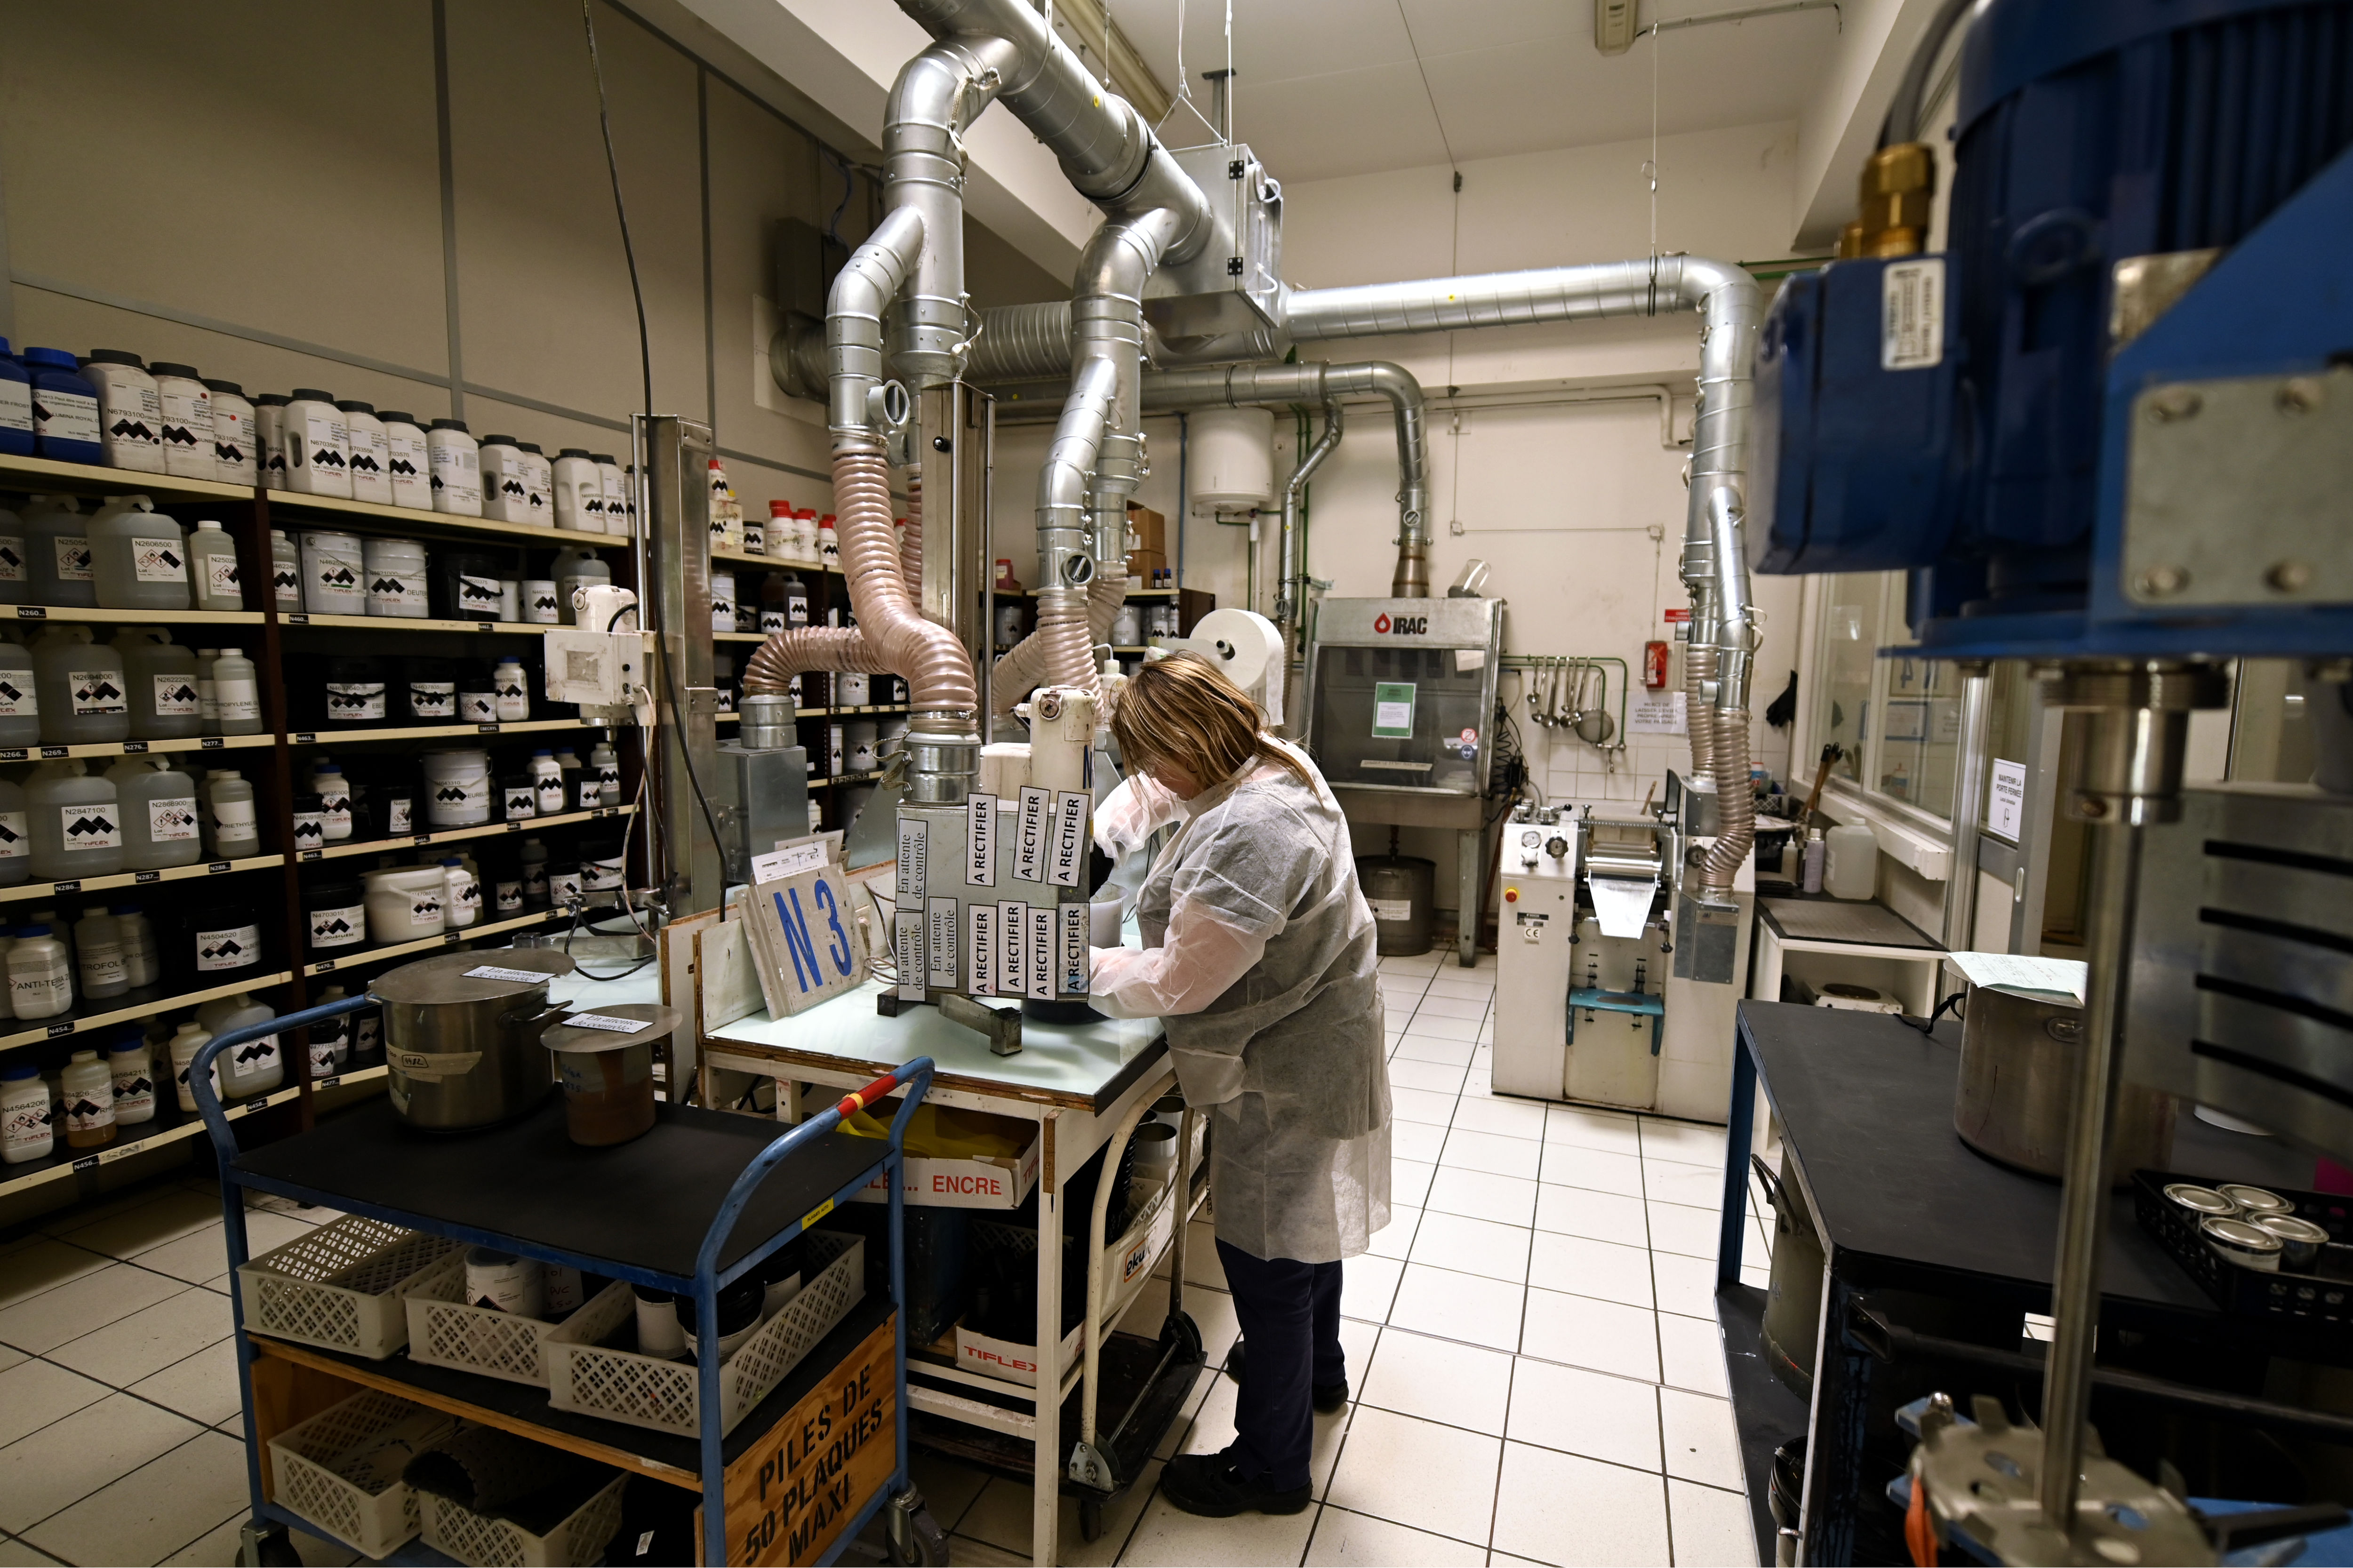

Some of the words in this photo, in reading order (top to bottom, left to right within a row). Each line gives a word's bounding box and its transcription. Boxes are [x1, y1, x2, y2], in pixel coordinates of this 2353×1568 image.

[107, 408, 144, 419] N6793100
[161, 415, 188, 425] 793100
[214, 433, 237, 442] 793100
[18, 609, 46, 617] N260...
[1393, 617, 1428, 635] IRAC
[1999, 774, 2017, 785] MAINTENIR
[2017, 779, 2022, 787] LA
[1996, 784, 2008, 793] PORTE
[65, 807, 105, 815] N2847100
[974, 801, 987, 870] RECTIFIER
[1022, 795, 1039, 864] RECTIFIER
[1060, 799, 1080, 867] RECTIFIER
[901, 834, 911, 878] attente
[914, 832, 925, 883] contrôle
[974, 872, 985, 883] A
[1021, 868, 1032, 878] A
[1057, 871, 1070, 882] A
[55, 883, 80, 891] N286...
[898, 879, 908, 895] En
[912, 885, 922, 899] de
[200, 932, 237, 941] N4504520
[773, 888, 823, 993] N
[814, 879, 852, 976] 3
[931, 912, 941, 955] attente
[944, 909, 955, 961] contrôle
[1008, 905, 1019, 973] RECTIFIER
[899, 927, 908, 966] attente
[912, 924, 922, 974] contrôle
[976, 912, 987, 980] RECTIFIER
[1036, 914, 1047, 982] RECTIFIER
[1068, 909, 1080, 976] RECTIFIER
[931, 957, 941, 972] En
[945, 963, 955, 977] de
[489, 973, 533, 982] contrôle
[504, 969, 541, 977] attente
[899, 969, 909, 986] En
[17, 976, 64, 990] ANTI-TERRA
[912, 977, 922, 991] de
[977, 984, 987, 993] A
[1008, 977, 1019, 987] A
[1068, 980, 1079, 990] A
[1036, 986, 1048, 996] A
[587, 1022, 630, 1031] contrôle
[602, 1017, 638, 1026] attente
[48, 1025, 74, 1035] N454...
[2, 1099, 46, 1113] N4564206
[24, 1132, 51, 1142] TIFLEX
[74, 1160, 99, 1170] N456...
[933, 1175, 1002, 1196] ENCRE
[759, 1404, 831, 1503] PILES
[843, 1363, 871, 1418] DE
[745, 1510, 776, 1565] 50
[783, 1398, 882, 1528] PLAQUES
[788, 1472, 849, 1568] MAXI
